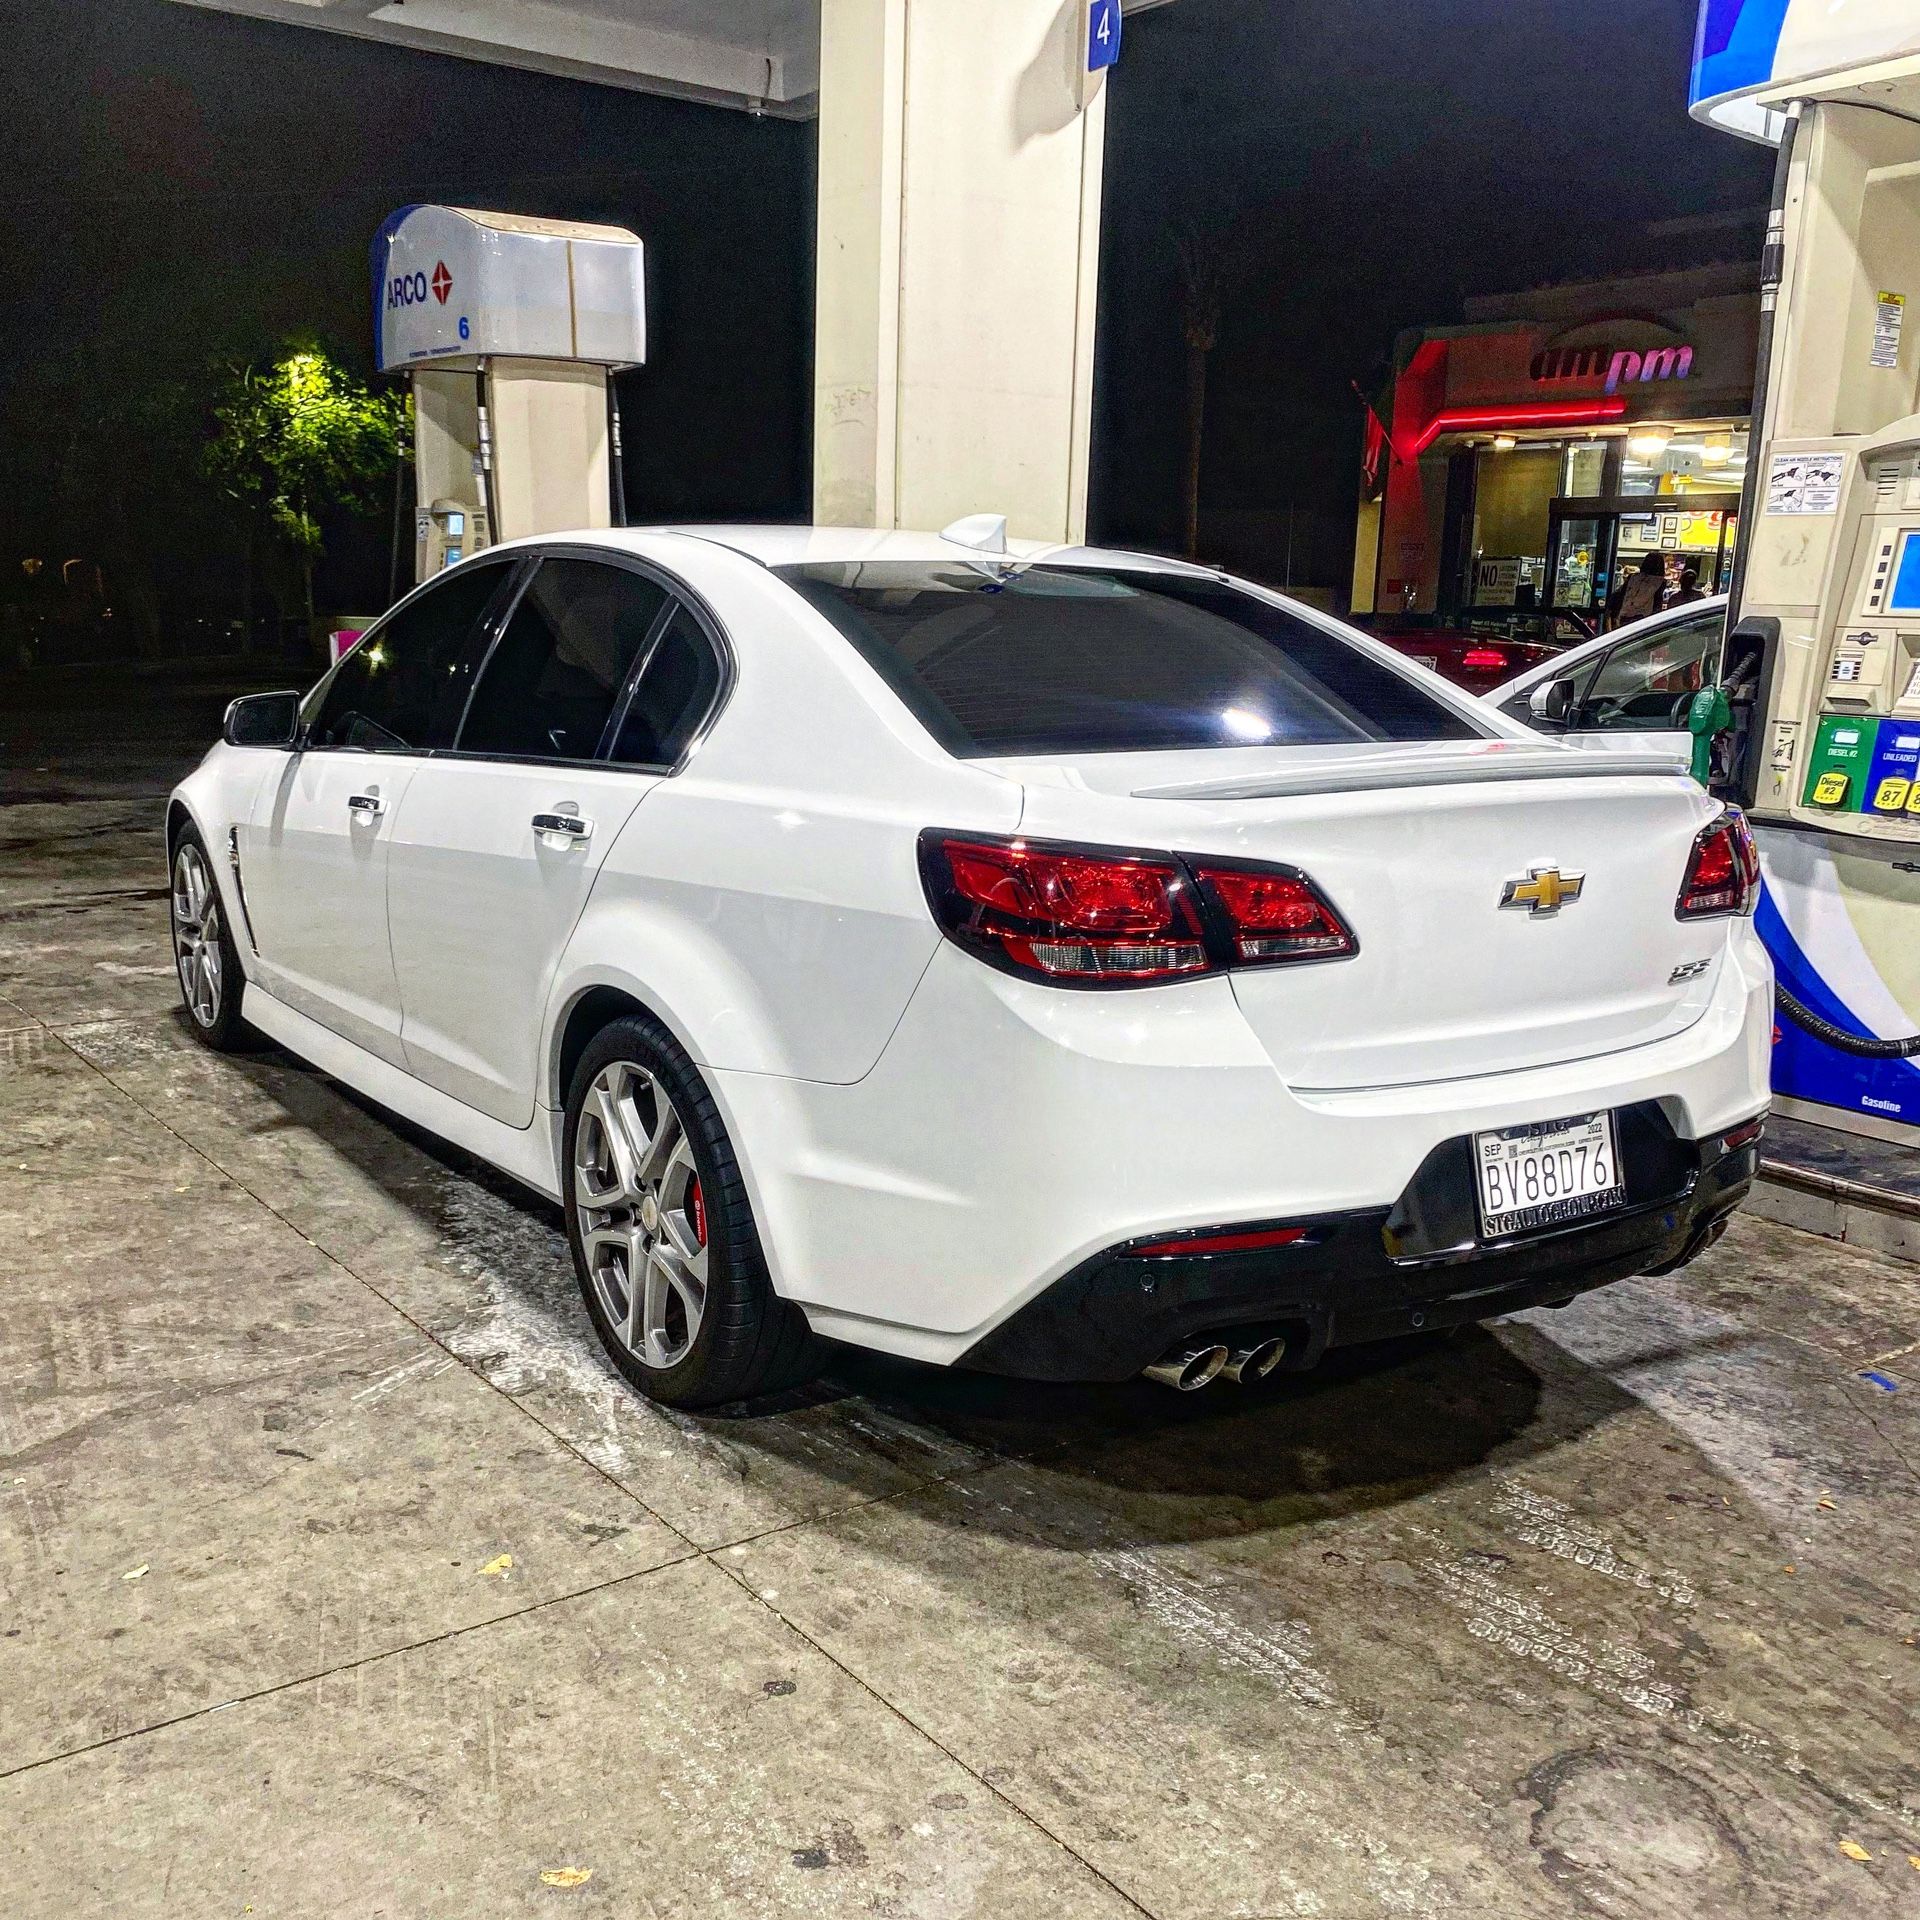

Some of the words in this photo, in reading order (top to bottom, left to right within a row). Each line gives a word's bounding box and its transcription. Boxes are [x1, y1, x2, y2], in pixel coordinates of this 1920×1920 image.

[1096, 7, 1111, 46] 4
[387, 271, 427, 310] ARCO
[458, 316, 470, 340] 6
[1480, 565, 1498, 587] NO
[1827, 748, 1849, 757] DIESEL
[1882, 752, 1918, 763] UNLEADED
[1820, 776, 1846, 788] Diesel
[1823, 786, 1836, 795] #2
[1881, 790, 1902, 803] 87
[1861, 1095, 1901, 1113] Gasoline
[1587, 1122, 1603, 1135] 2022
[1484, 1143, 1502, 1157] SEP
[1486, 1142, 1607, 1211] BV88D76
